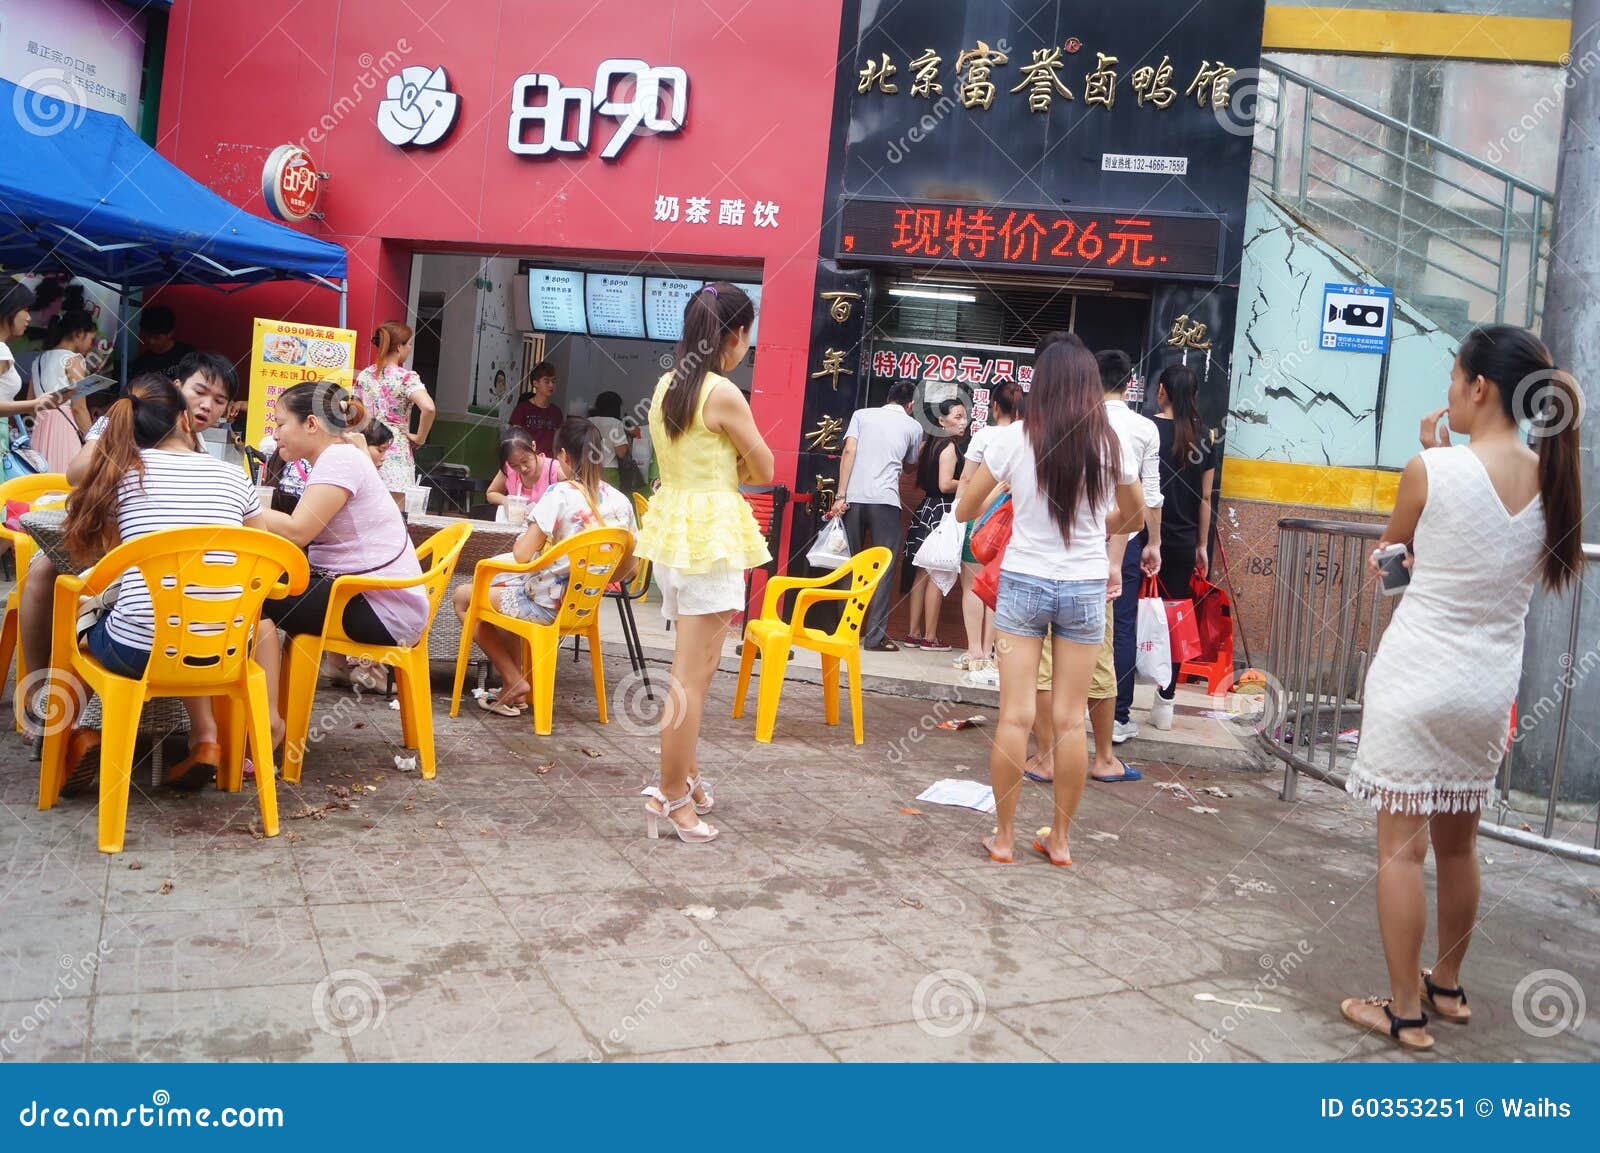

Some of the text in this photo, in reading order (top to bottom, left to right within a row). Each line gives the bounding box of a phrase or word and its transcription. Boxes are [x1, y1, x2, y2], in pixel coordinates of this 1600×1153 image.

[507, 57, 690, 161] 8090
[283, 166, 317, 198] 8090
[653, 194, 781, 228] 奶茶酷饮
[874, 351, 1015, 385] 特价26元/只
